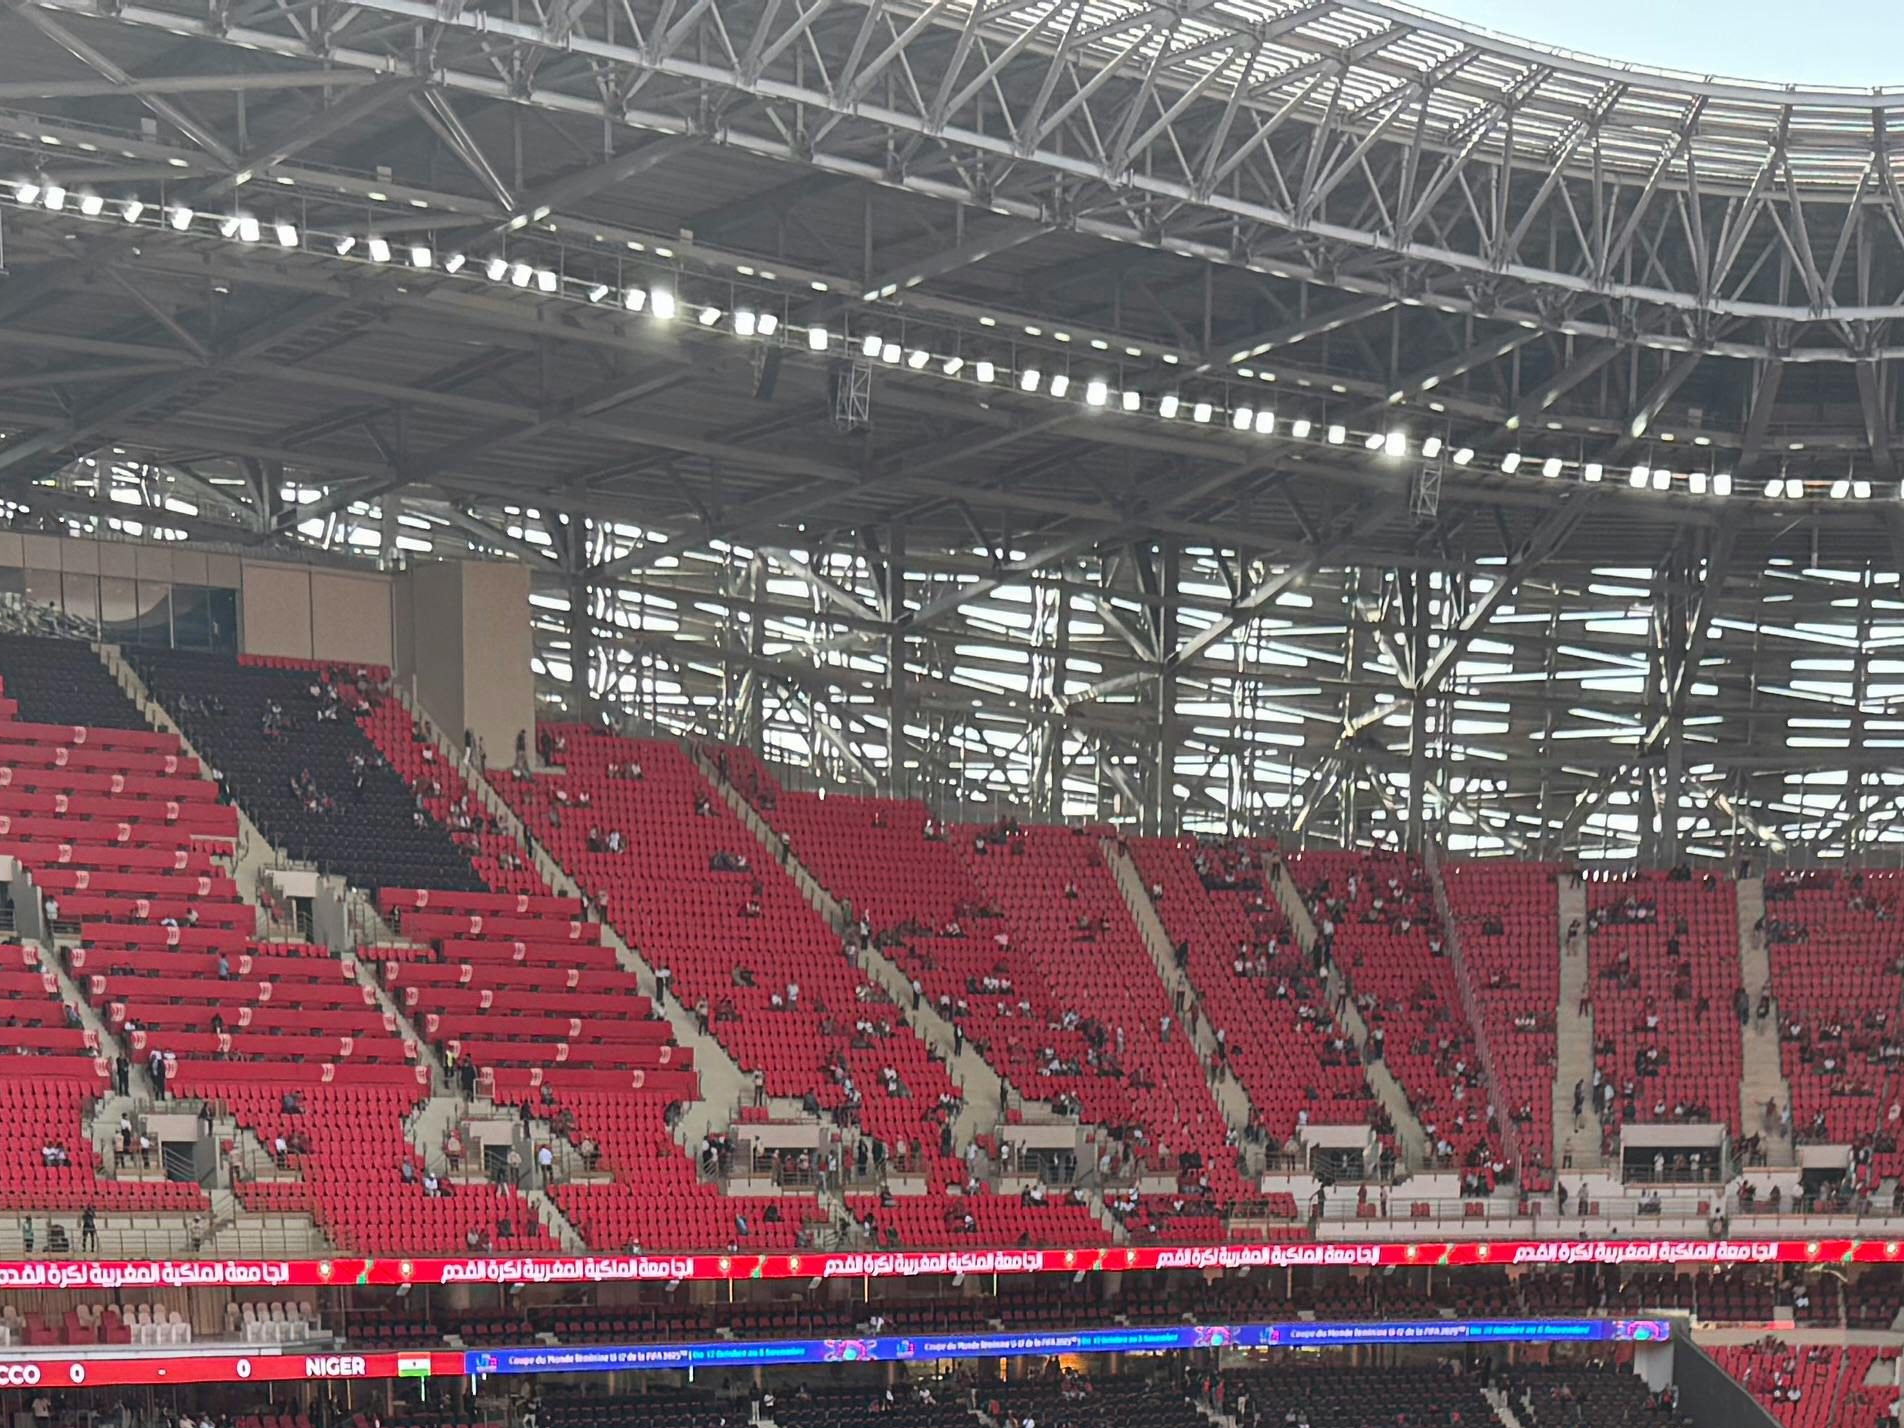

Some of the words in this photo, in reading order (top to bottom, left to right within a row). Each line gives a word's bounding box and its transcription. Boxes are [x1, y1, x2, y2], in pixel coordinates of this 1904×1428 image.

[48, 1264, 87, 1288] لكرة
[90, 1263, 160, 1287] المغربية
[162, 1262, 223, 1286] الملكية
[69, 1363, 85, 1384] 0
[236, 1358, 251, 1378] 0
[305, 1356, 366, 1376] NIGER
